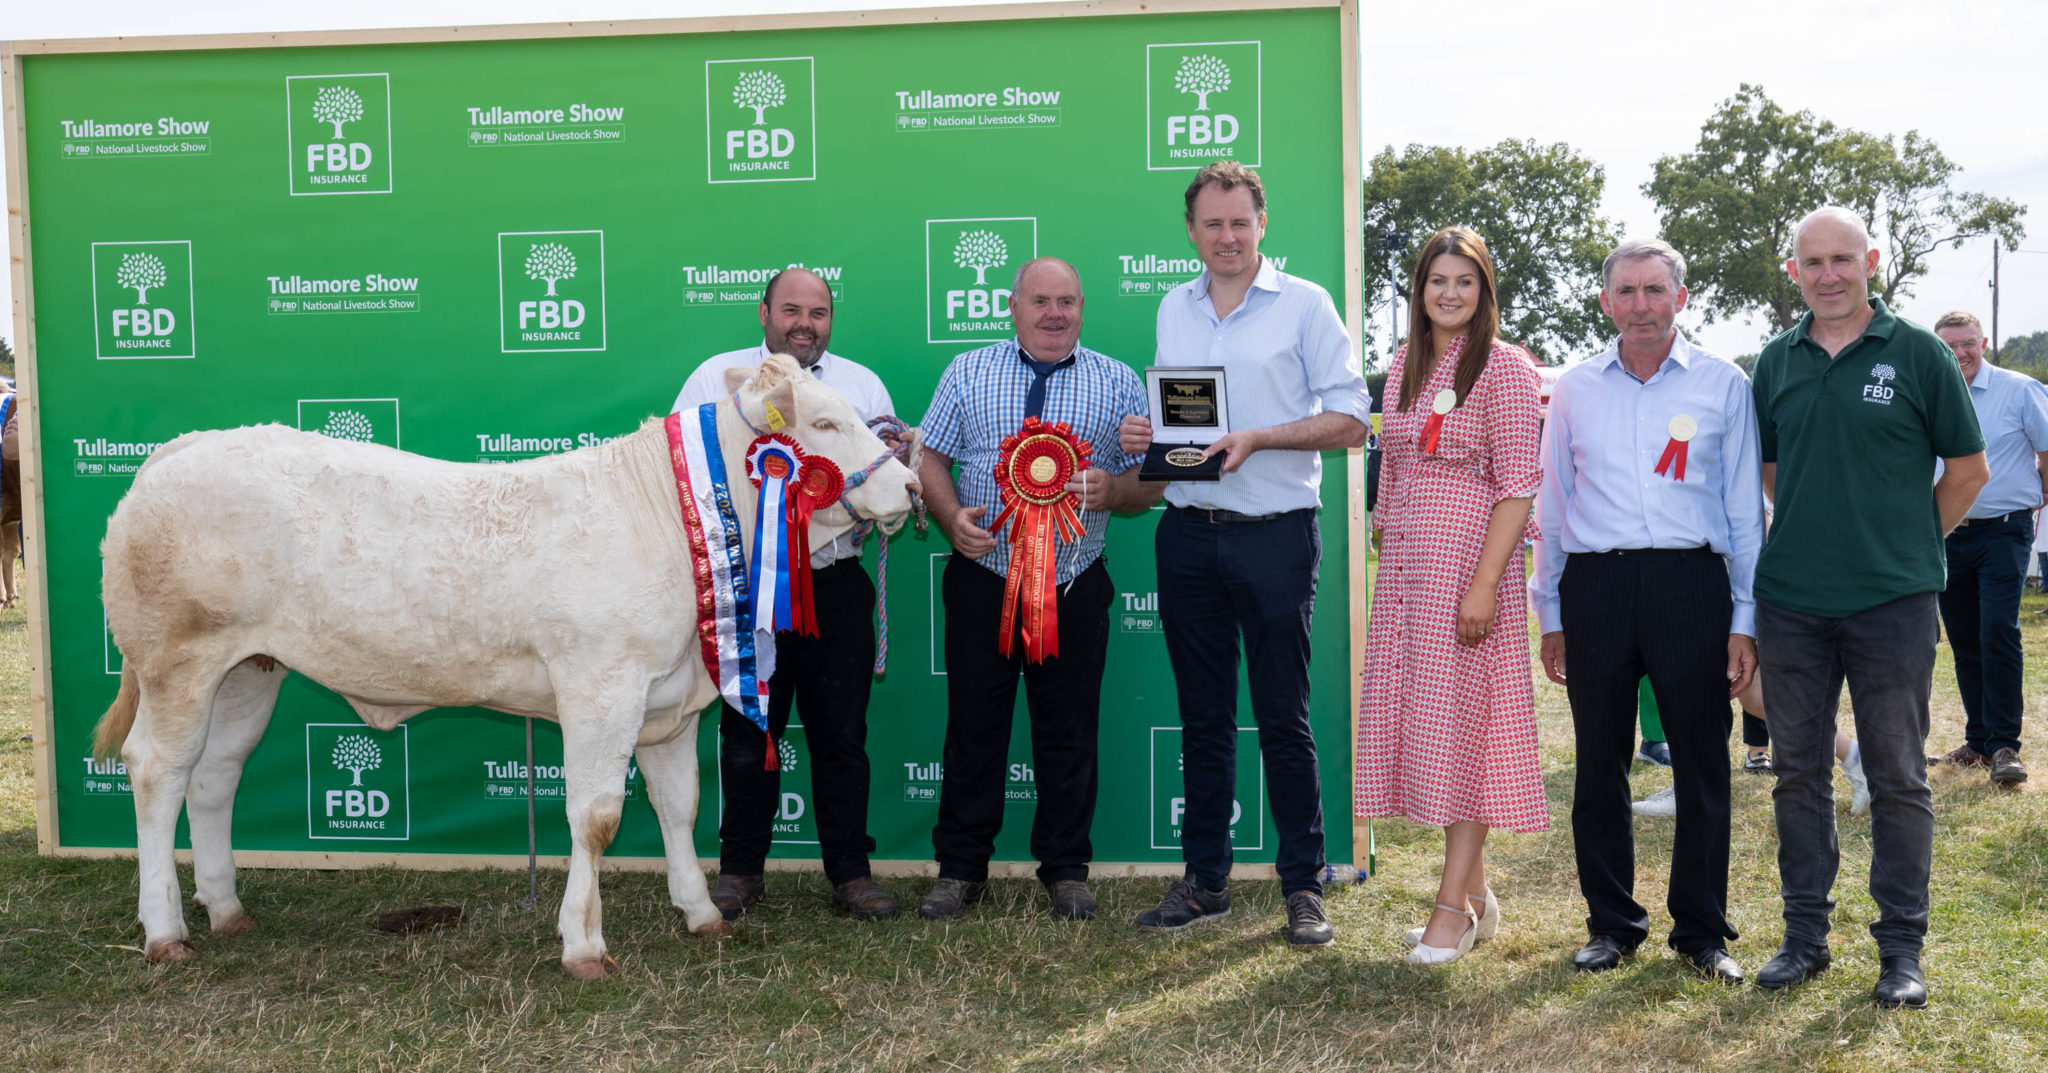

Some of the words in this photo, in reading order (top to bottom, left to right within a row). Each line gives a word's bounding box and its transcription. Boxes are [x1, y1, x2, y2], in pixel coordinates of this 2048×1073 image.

[896, 90, 997, 109] Tullamore
[1003, 87, 1060, 106] Show
[467, 107, 564, 125] Tullamore
[570, 104, 623, 122] Show
[912, 118, 927, 127] FBD
[933, 115, 975, 126] National
[979, 115, 1025, 124] Livestock
[1028, 114, 1055, 123] Show
[61, 120, 152, 137] Tullamore
[158, 117, 209, 135] Show
[1168, 114, 1239, 145] FBD
[483, 134, 497, 142] FBD
[504, 132, 544, 141] National
[547, 131, 590, 140] Livestock
[594, 130, 620, 139] Show
[74, 146, 90, 154] FBD
[96, 145, 134, 153] National
[136, 143, 178, 153] Livestock
[181, 143, 206, 151] Show
[727, 129, 794, 159] FBD
[308, 143, 371, 172] FBD
[1170, 148, 1232, 157] INSURANCE
[730, 161, 789, 171] INSURANCE
[311, 175, 367, 184] INSURANCE
[683, 265, 779, 284] Tullamore
[267, 276, 360, 294] Tullamore
[366, 274, 418, 292] Show
[1135, 283, 1150, 292] FBD
[699, 293, 713, 301] FBD
[720, 291, 760, 301] National
[282, 302, 296, 311] FBD
[303, 301, 341, 310] National
[344, 300, 386, 309] Livestock
[389, 299, 414, 308] Show
[947, 289, 1011, 319] FBD
[520, 300, 585, 329] FBD
[113, 308, 175, 336] FBD
[950, 322, 1010, 331] INSURANCE
[522, 332, 580, 341] INSURANCE
[116, 340, 170, 348] INSURANCE
[1863, 384, 1894, 399] FBD
[476, 434, 572, 452] Tullamore
[89, 464, 103, 472] FBD
[679, 480, 694, 506] SHOW
[714, 482, 733, 516] 2022
[98, 783, 111, 791] FBD
[499, 787, 513, 795] FBD
[520, 786, 558, 796] Ntional
[326, 790, 389, 817] FBD
[329, 821, 384, 829] INSURANCE
